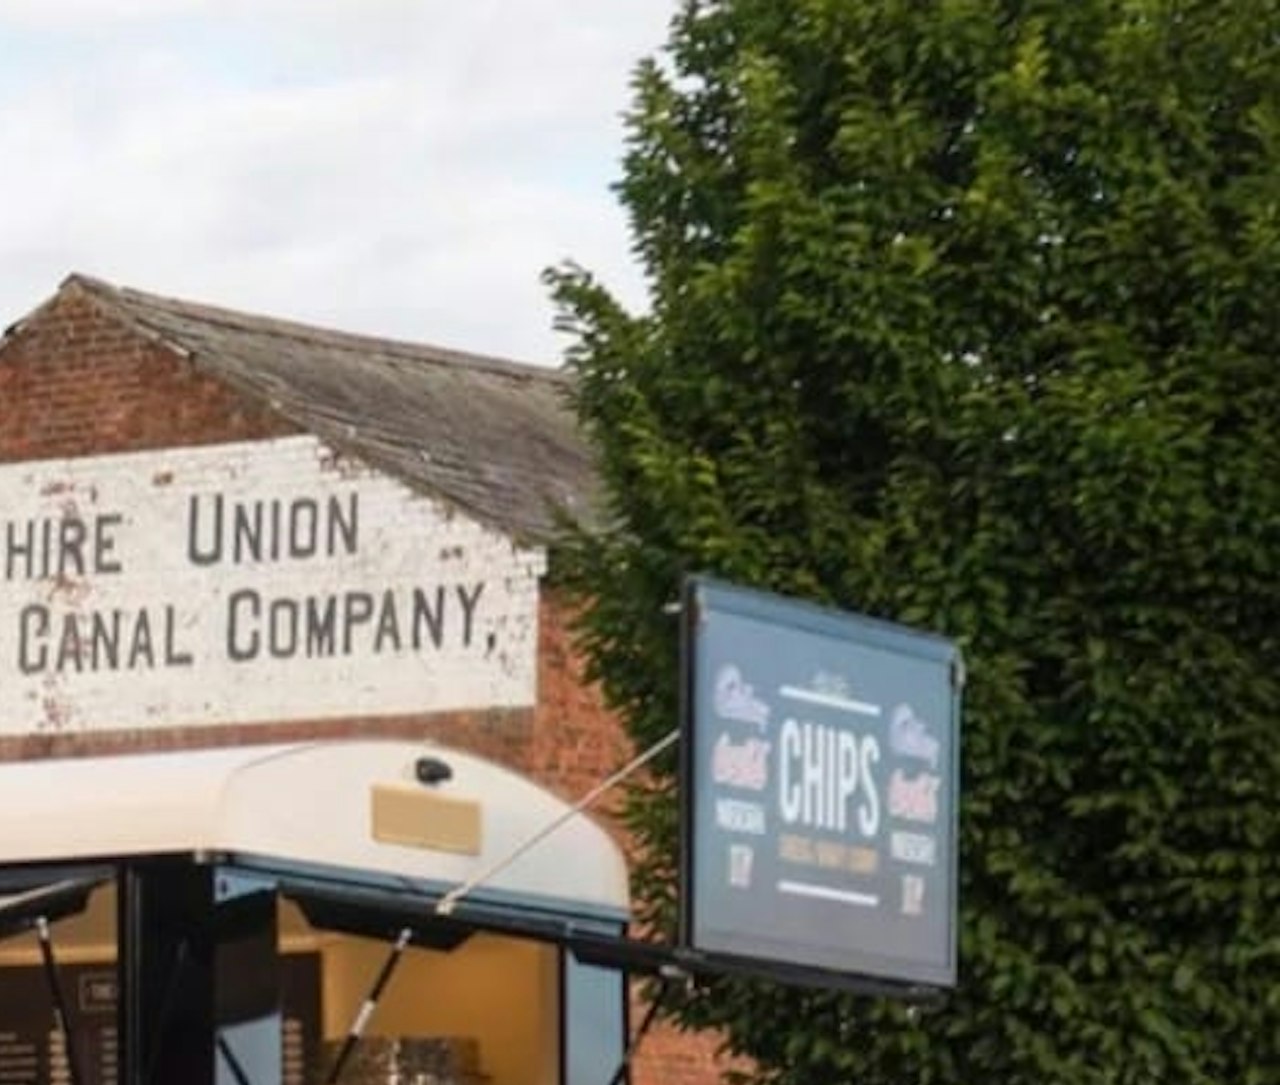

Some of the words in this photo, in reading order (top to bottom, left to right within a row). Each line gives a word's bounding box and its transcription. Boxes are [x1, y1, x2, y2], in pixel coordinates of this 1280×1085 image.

[188, 492, 359, 565] UNION
[18, 603, 193, 676] CANAL
[778, 717, 882, 838] CHIPS
